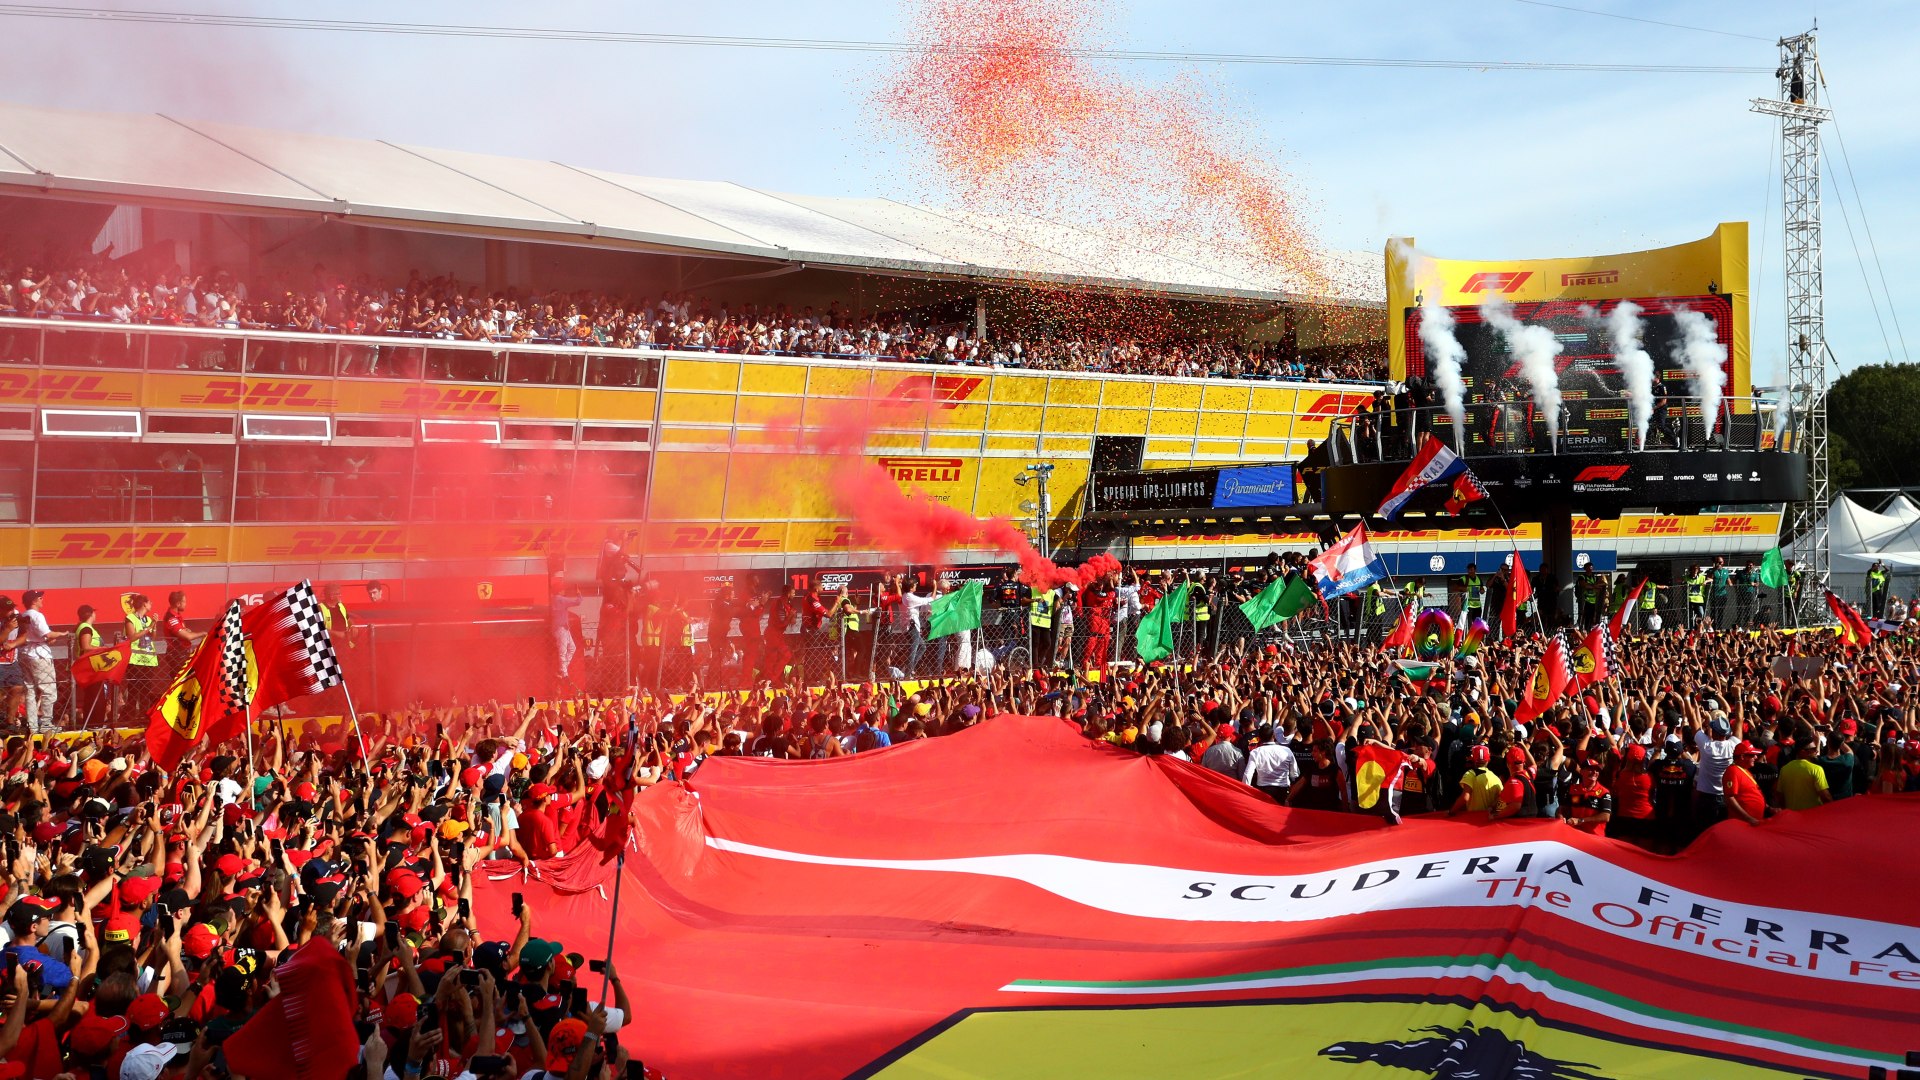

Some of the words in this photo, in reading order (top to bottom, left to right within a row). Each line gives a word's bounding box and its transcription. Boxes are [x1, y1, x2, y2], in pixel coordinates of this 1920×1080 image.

[1561, 270, 1619, 287] PIRELLI
[202, 381, 320, 407] DHL
[400, 387, 502, 412] DHL
[1103, 485, 1140, 500] SPECIAL
[1571, 519, 1602, 535] HL
[1635, 518, 1680, 534] DHL
[1711, 517, 1752, 532] DHL
[56, 532, 193, 559] DHL
[289, 530, 407, 555] DHL
[671, 527, 763, 548] DHL
[791, 574, 808, 590] 11
[821, 573, 853, 583] SERGIO
[917, 571, 927, 587] 1
[939, 570, 961, 579] MAX
[1181, 852, 1585, 901] SCUDERIA
[1638, 885, 1920, 964] FERRA
[1478, 877, 1572, 908] The
[1592, 902, 1819, 970] Official
